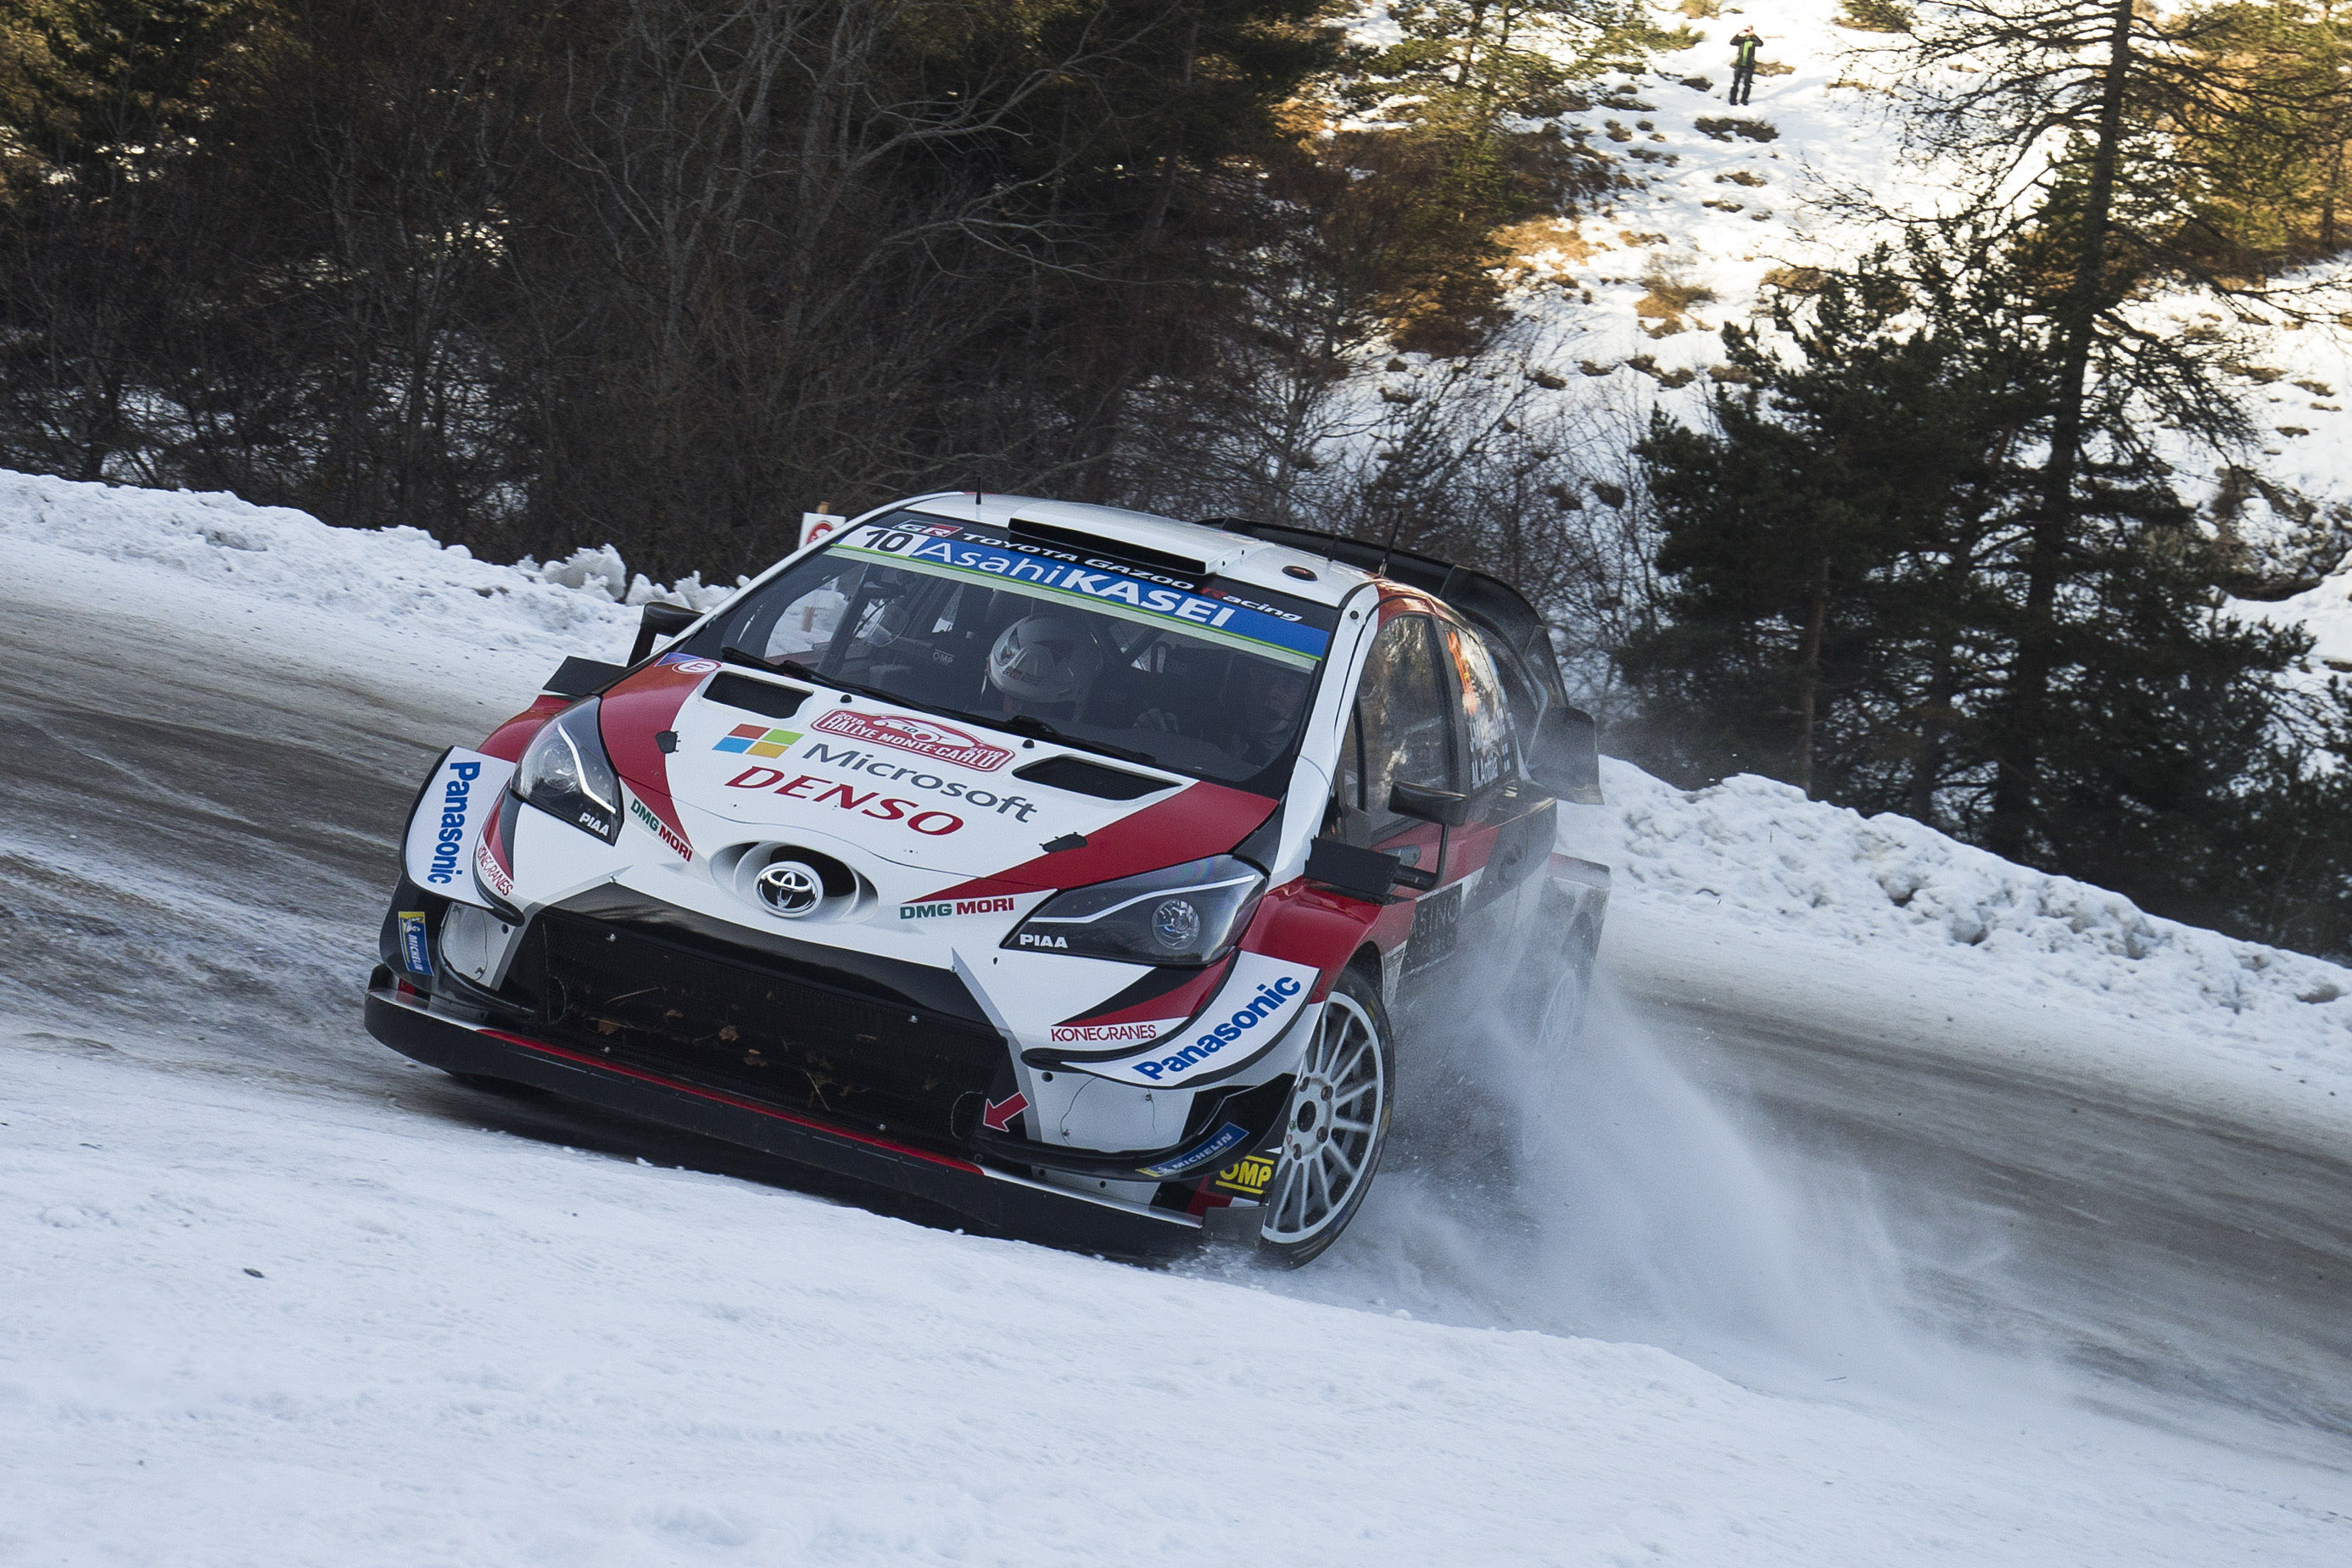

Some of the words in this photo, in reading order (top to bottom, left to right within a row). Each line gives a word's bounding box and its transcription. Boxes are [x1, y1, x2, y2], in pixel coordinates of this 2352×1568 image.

[863, 529, 913, 552] 10
[897, 523, 951, 537] GR
[963, 533, 1077, 561] TOYOTA
[1085, 559, 1194, 589] GAZOO
[1198, 587, 1303, 622] Racing
[933, 651, 953, 665] OMP
[835, 712, 865, 725] 2019
[901, 725, 918, 734] 10
[821, 716, 877, 738] RALLYE
[878, 732, 999, 768] MONTE-CARLO
[802, 743, 1037, 823] Microsoft
[724, 766, 964, 835] DENSO
[427, 762, 481, 884] Panasonic
[578, 812, 611, 836] PIAA
[630, 798, 660, 832] DMG
[657, 824, 693, 862] MORI
[900, 903, 953, 919] DMG
[957, 897, 1014, 915] MORI
[1020, 934, 1069, 948] PIAA
[1050, 1024, 1156, 1042] KONECRANES
[1131, 976, 1301, 1080] Panasonic
[1172, 1132, 1233, 1169] MICHELIN
